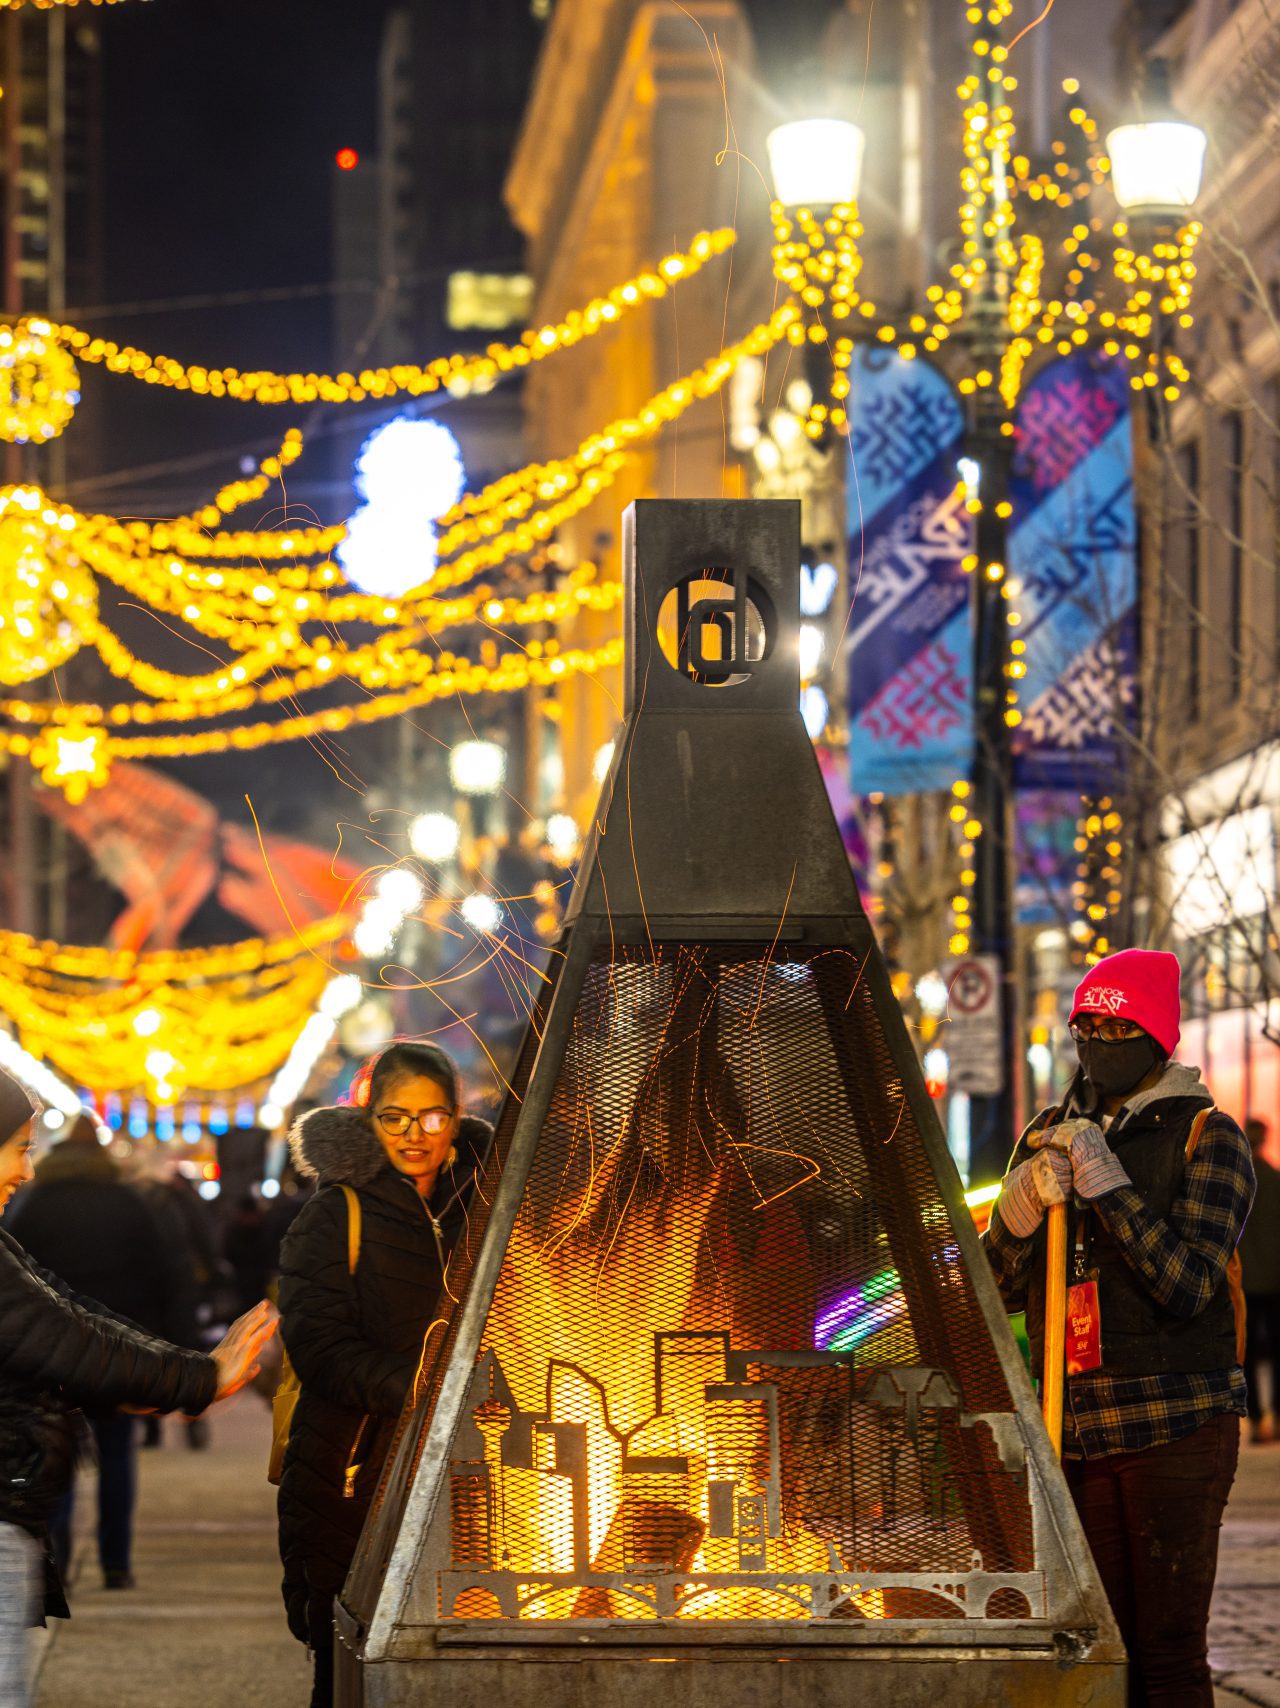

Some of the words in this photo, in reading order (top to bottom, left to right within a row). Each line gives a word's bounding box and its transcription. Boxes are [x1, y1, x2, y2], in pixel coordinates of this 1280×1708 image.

[1089, 986, 1124, 997] CHINOOK
[1080, 992, 1128, 1016] BLAST
[1072, 1313, 1092, 1327] Event
[1074, 1323, 1090, 1337] Staff
